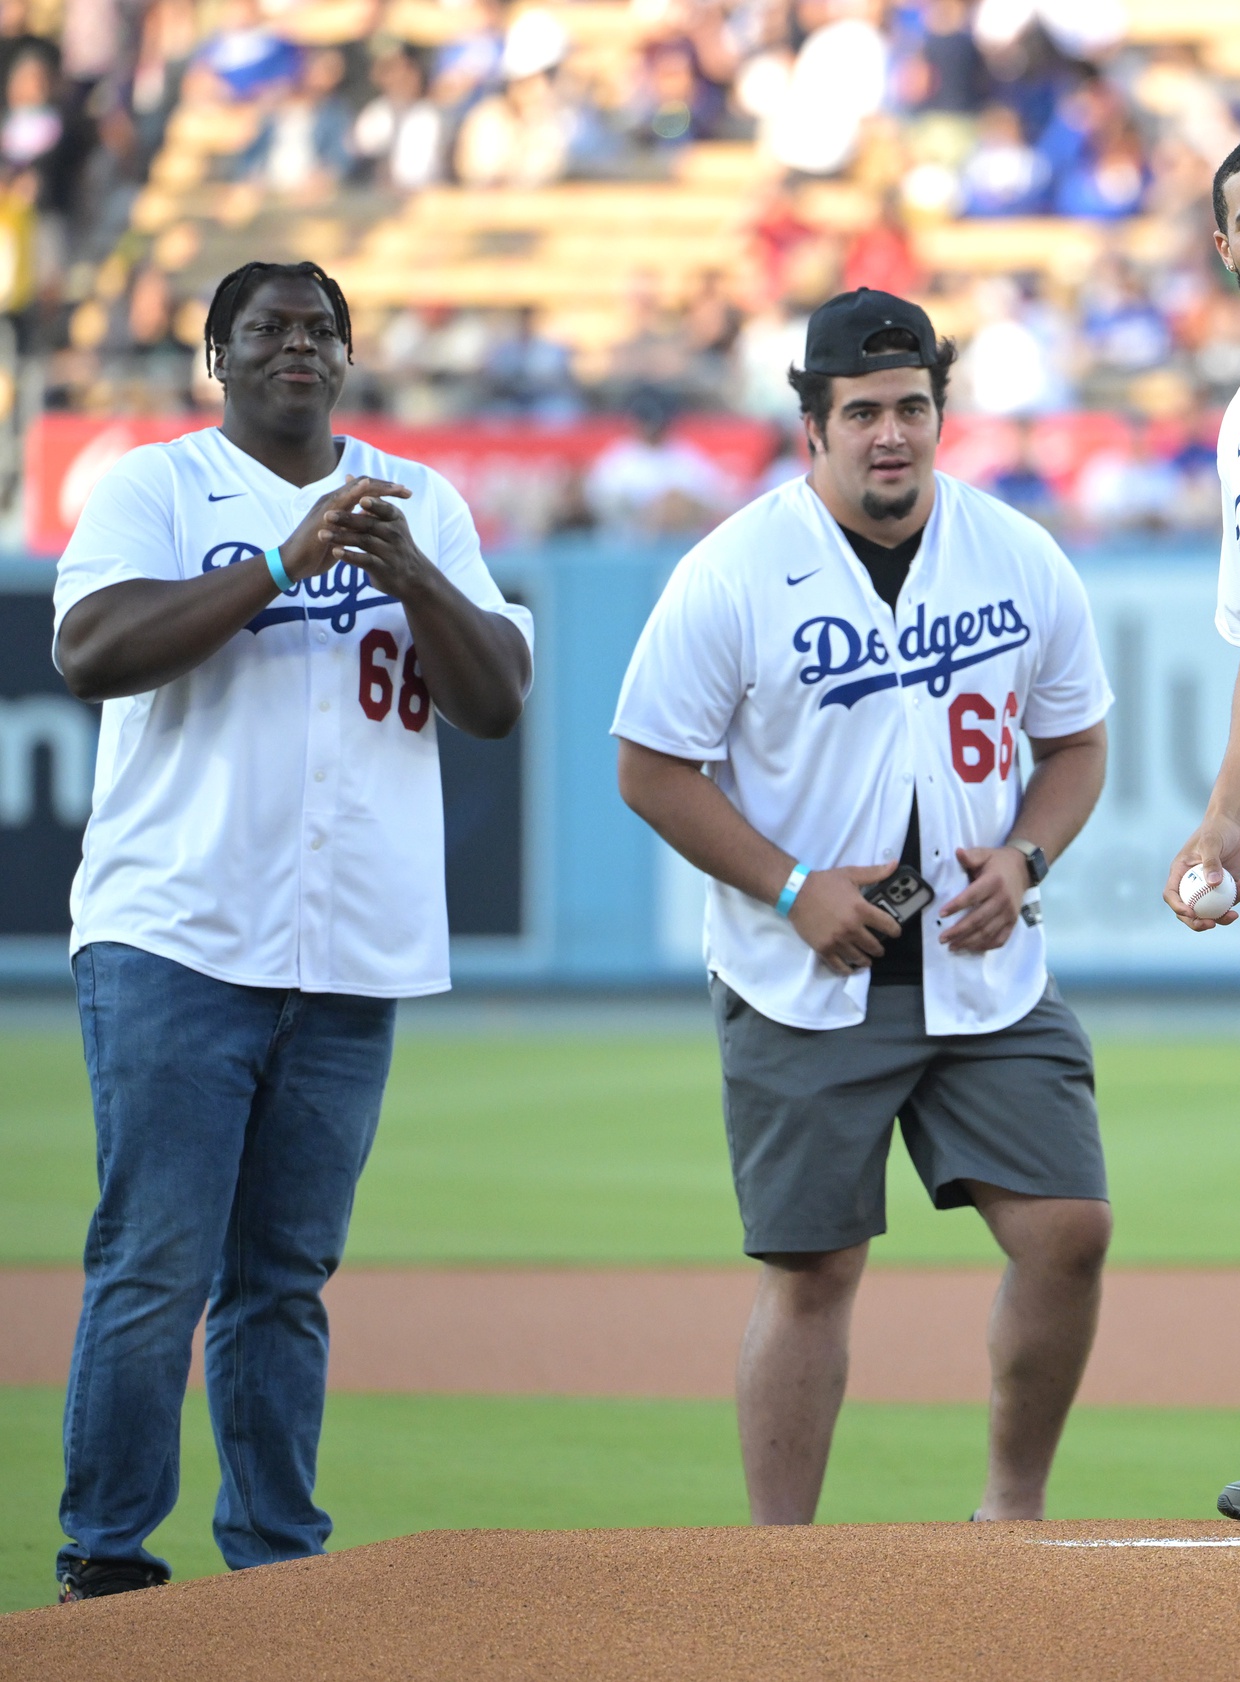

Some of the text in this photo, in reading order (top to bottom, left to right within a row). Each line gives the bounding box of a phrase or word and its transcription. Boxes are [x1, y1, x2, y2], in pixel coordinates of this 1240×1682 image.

[358, 628, 430, 732] 68
[793, 599, 1031, 698] Dodgers
[948, 691, 1019, 783] 66
